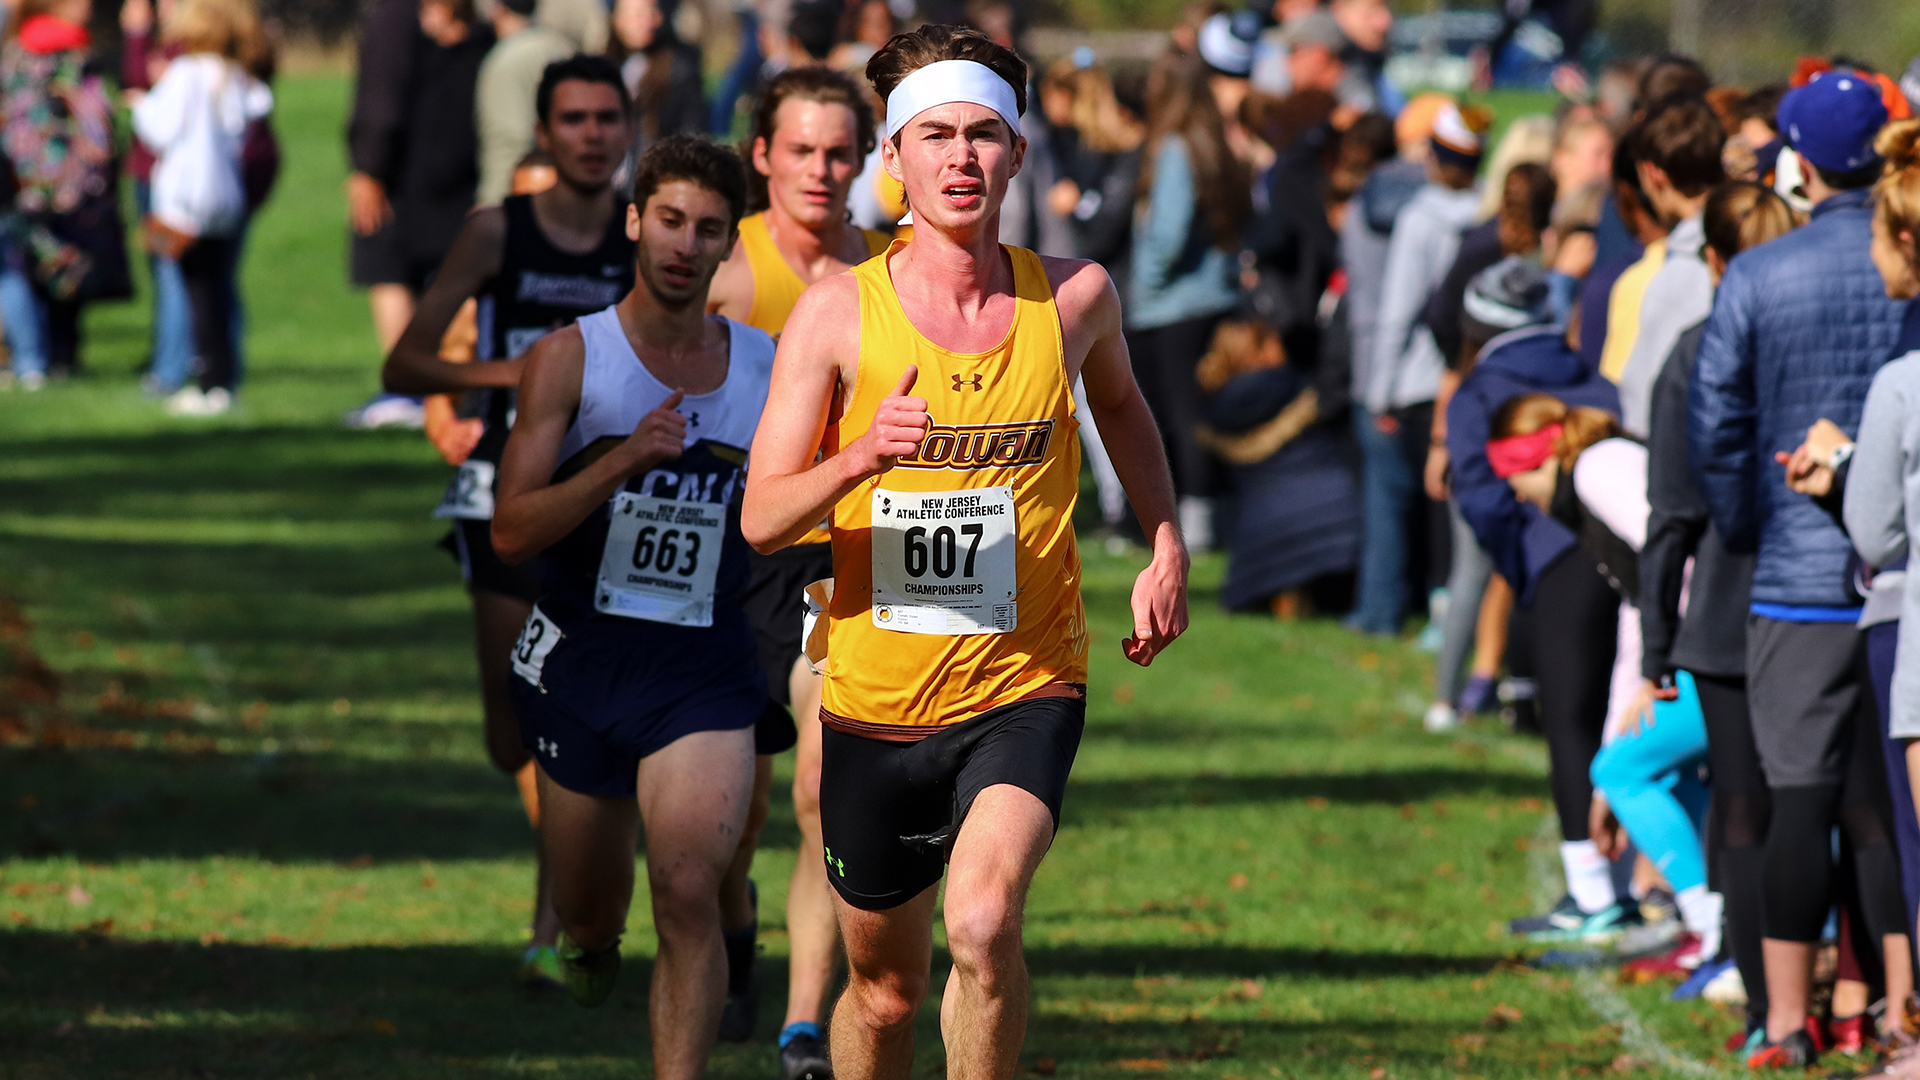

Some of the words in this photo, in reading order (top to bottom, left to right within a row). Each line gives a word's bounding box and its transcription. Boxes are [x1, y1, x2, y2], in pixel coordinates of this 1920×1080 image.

[898, 418, 1053, 468] owan
[896, 509, 942, 520] ATHLETIC
[944, 504, 1005, 519] CONFERENCE
[922, 499, 943, 509] NEW
[946, 495, 981, 507] JERSEY
[632, 526, 701, 577] 663
[904, 523, 984, 579] 607
[904, 583, 984, 596] CHAMPIONSHIPS
[515, 618, 545, 665] 3
